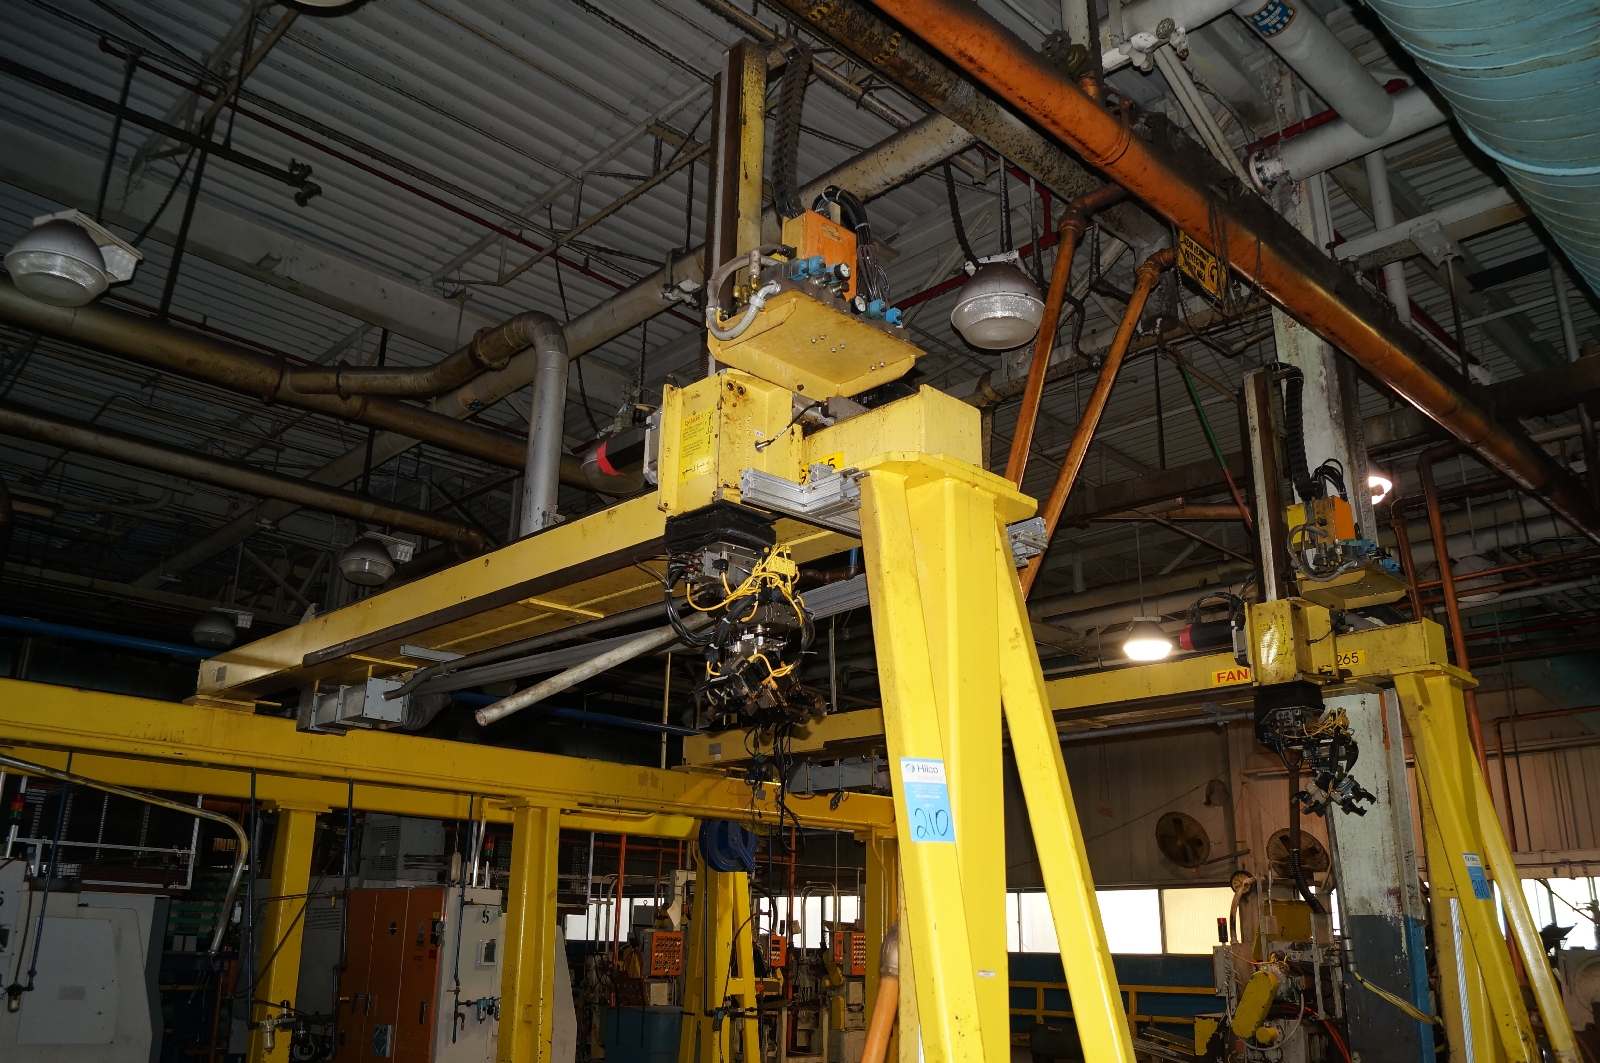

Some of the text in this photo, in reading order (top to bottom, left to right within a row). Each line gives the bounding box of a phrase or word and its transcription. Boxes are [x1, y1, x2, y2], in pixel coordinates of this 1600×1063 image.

[1337, 653, 1359, 666] 265
[916, 763, 940, 775] Hilco
[914, 807, 949, 839] 210
